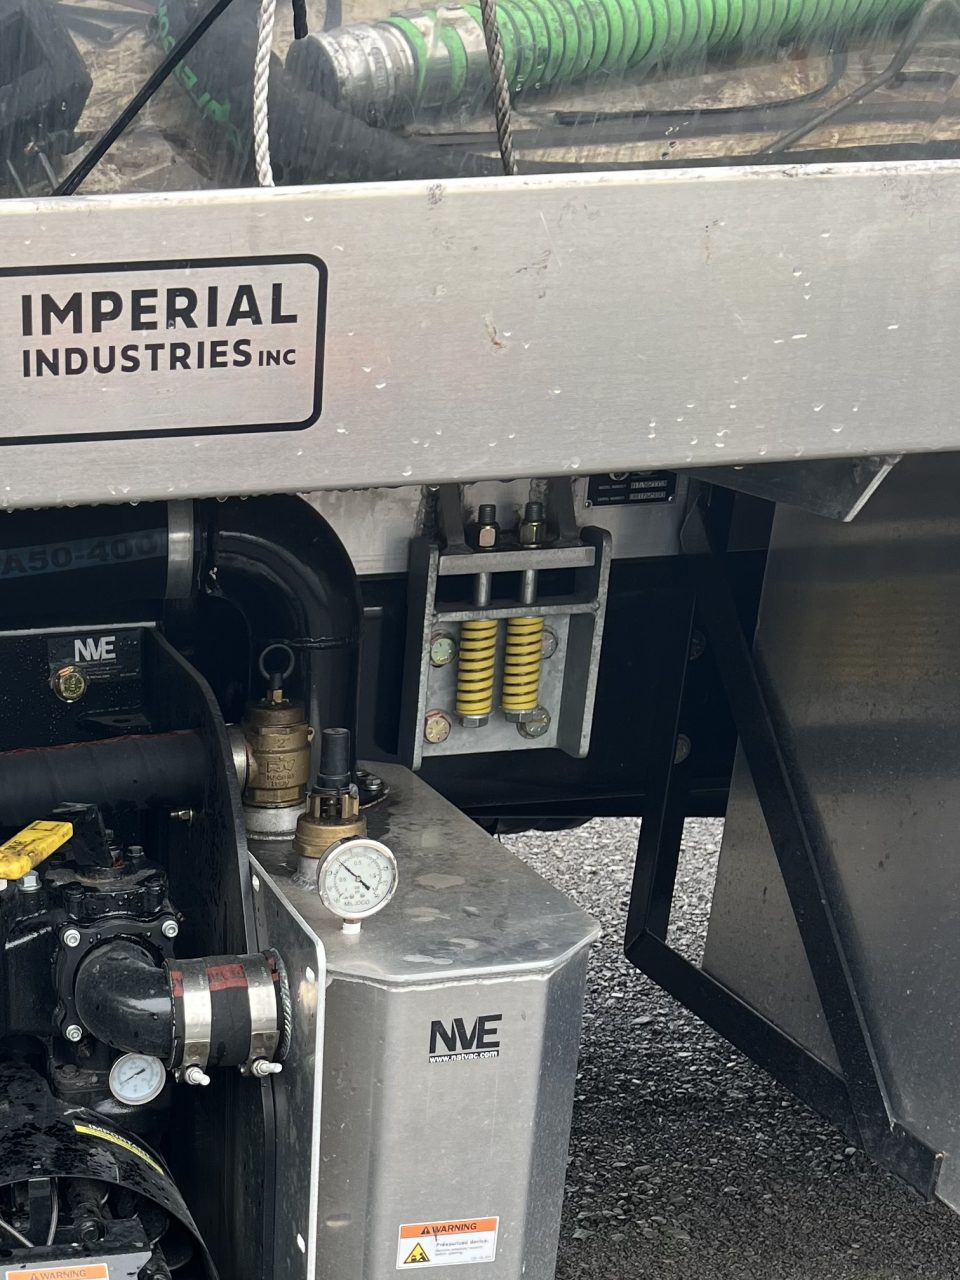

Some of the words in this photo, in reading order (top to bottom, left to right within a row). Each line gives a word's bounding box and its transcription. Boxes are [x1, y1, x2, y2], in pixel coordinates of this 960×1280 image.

[21, 282, 298, 337] IMPERIAL
[22, 338, 253, 378] INDUSTRIES
[258, 348, 297, 368] INC
[74, 636, 116, 662] NVE
[429, 1013, 502, 1054] NVE
[429, 1051, 498, 1063] www.natvac.com
[431, 1222, 477, 1234] WARNING
[40, 1269, 87, 1280] WARNING
